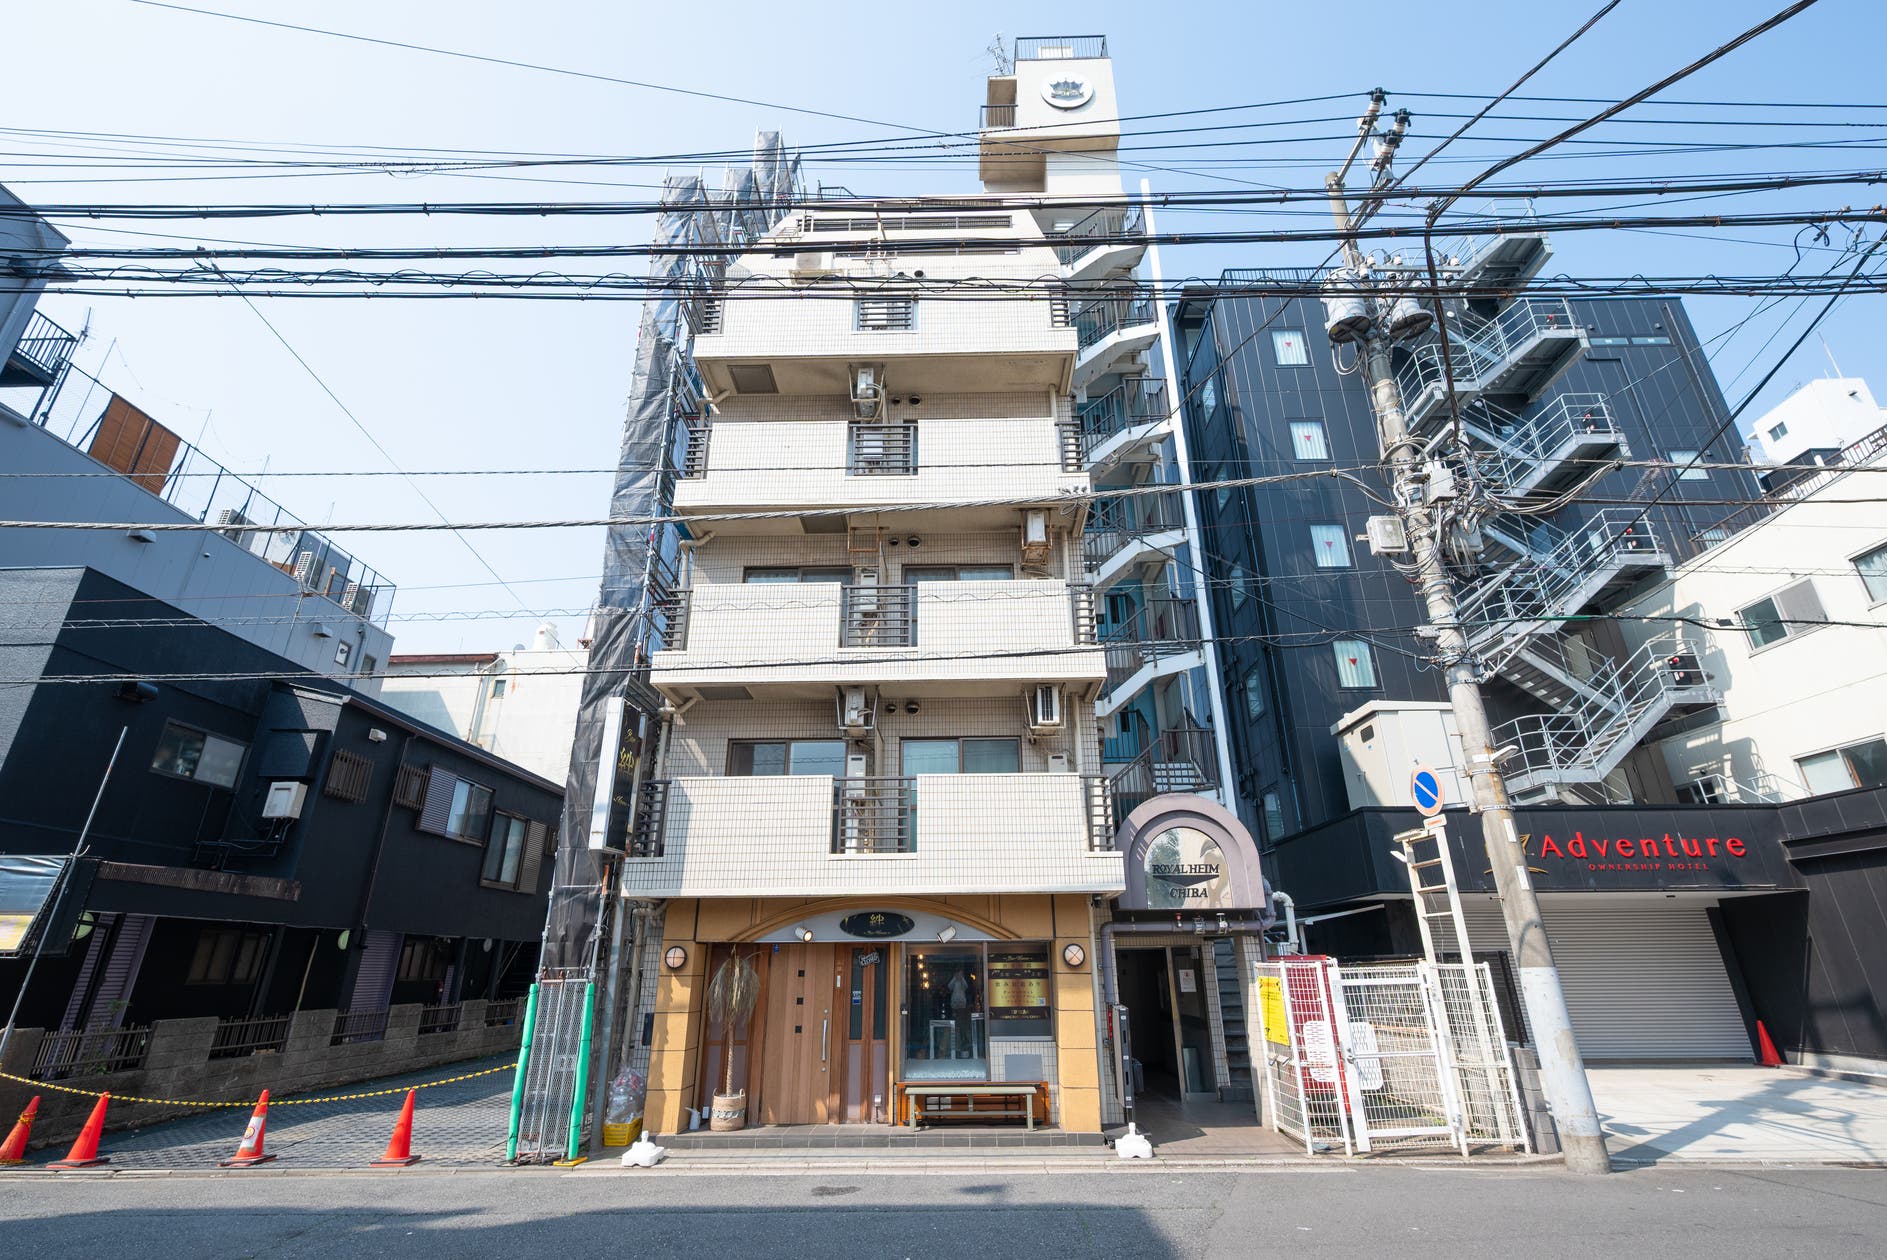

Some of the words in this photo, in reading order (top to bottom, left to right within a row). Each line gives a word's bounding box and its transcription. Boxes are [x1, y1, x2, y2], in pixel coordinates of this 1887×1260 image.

[1541, 831, 1748, 860] Adventure
[1588, 863, 1661, 871] OWNERSHIP
[1668, 863, 1710, 871] HOTEL
[1169, 887, 1209, 898] CHIBA
